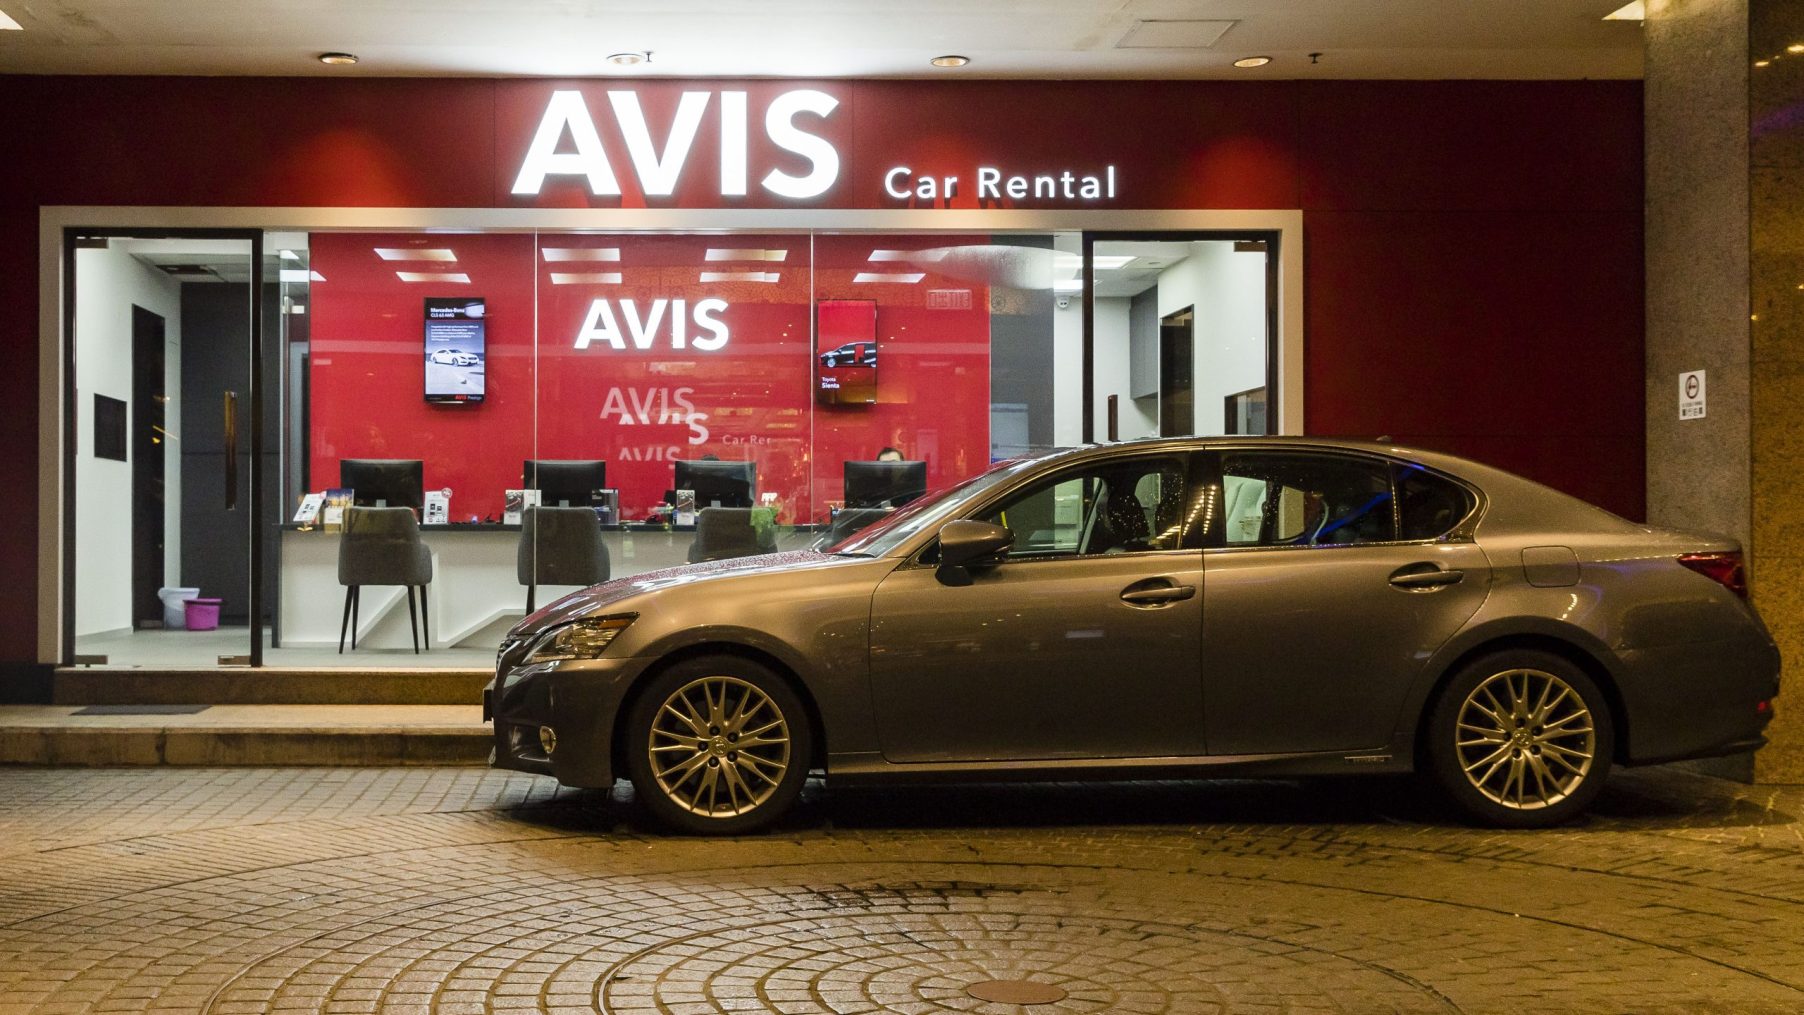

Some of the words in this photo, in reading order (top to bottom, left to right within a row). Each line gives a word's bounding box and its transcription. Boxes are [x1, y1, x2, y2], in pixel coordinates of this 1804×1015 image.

[511, 89, 840, 198] AVIS
[884, 167, 957, 200] Car
[977, 165, 1117, 200] Rental
[573, 298, 730, 351] AVIS
